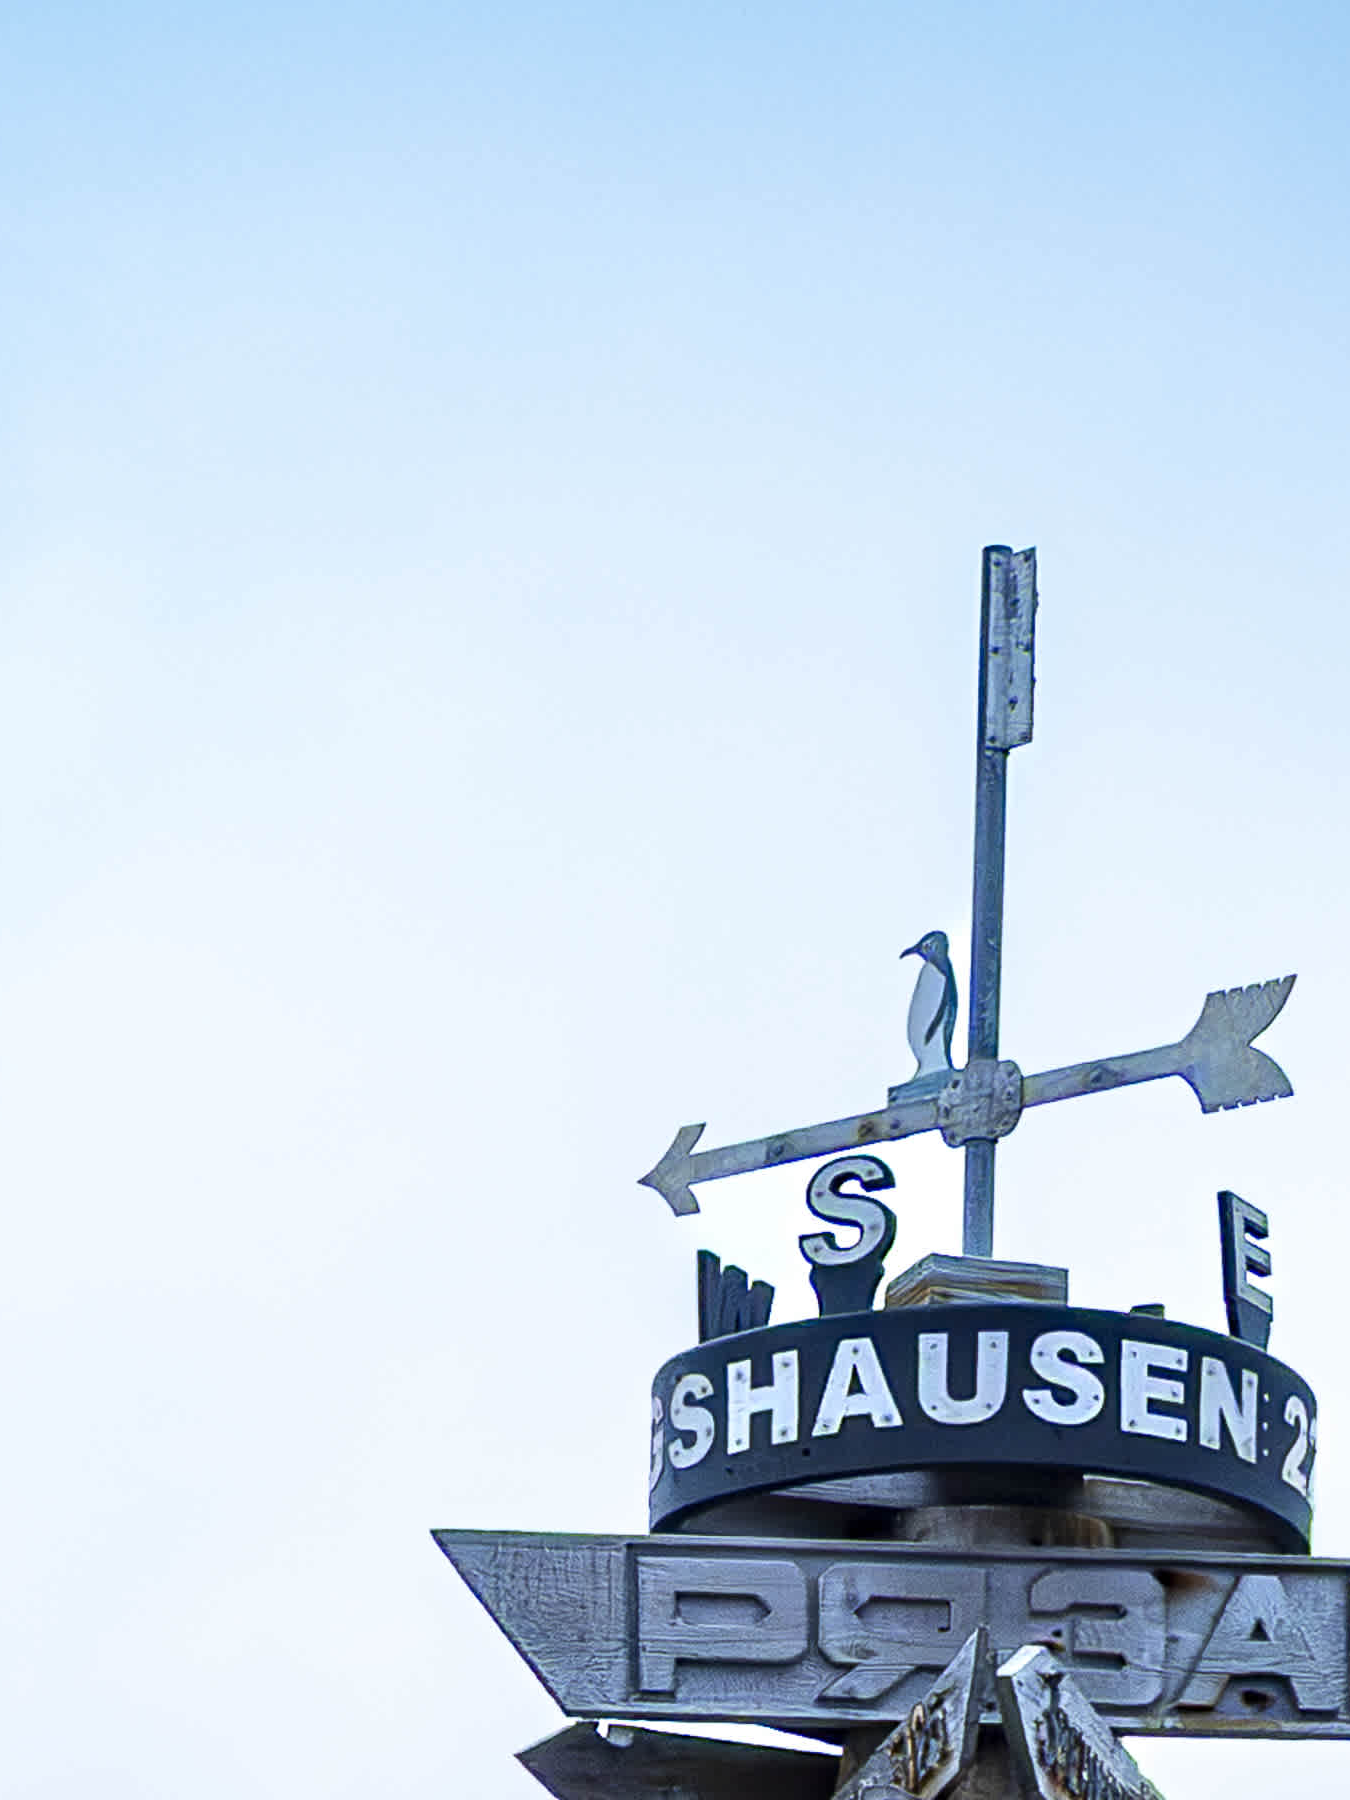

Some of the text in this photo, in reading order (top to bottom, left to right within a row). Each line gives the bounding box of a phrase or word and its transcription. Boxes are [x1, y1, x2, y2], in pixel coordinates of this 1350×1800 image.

[799, 1155, 897, 1266] S
[1217, 1189, 1273, 1315] E
[651, 1331, 1258, 1494] SHAUSEN
